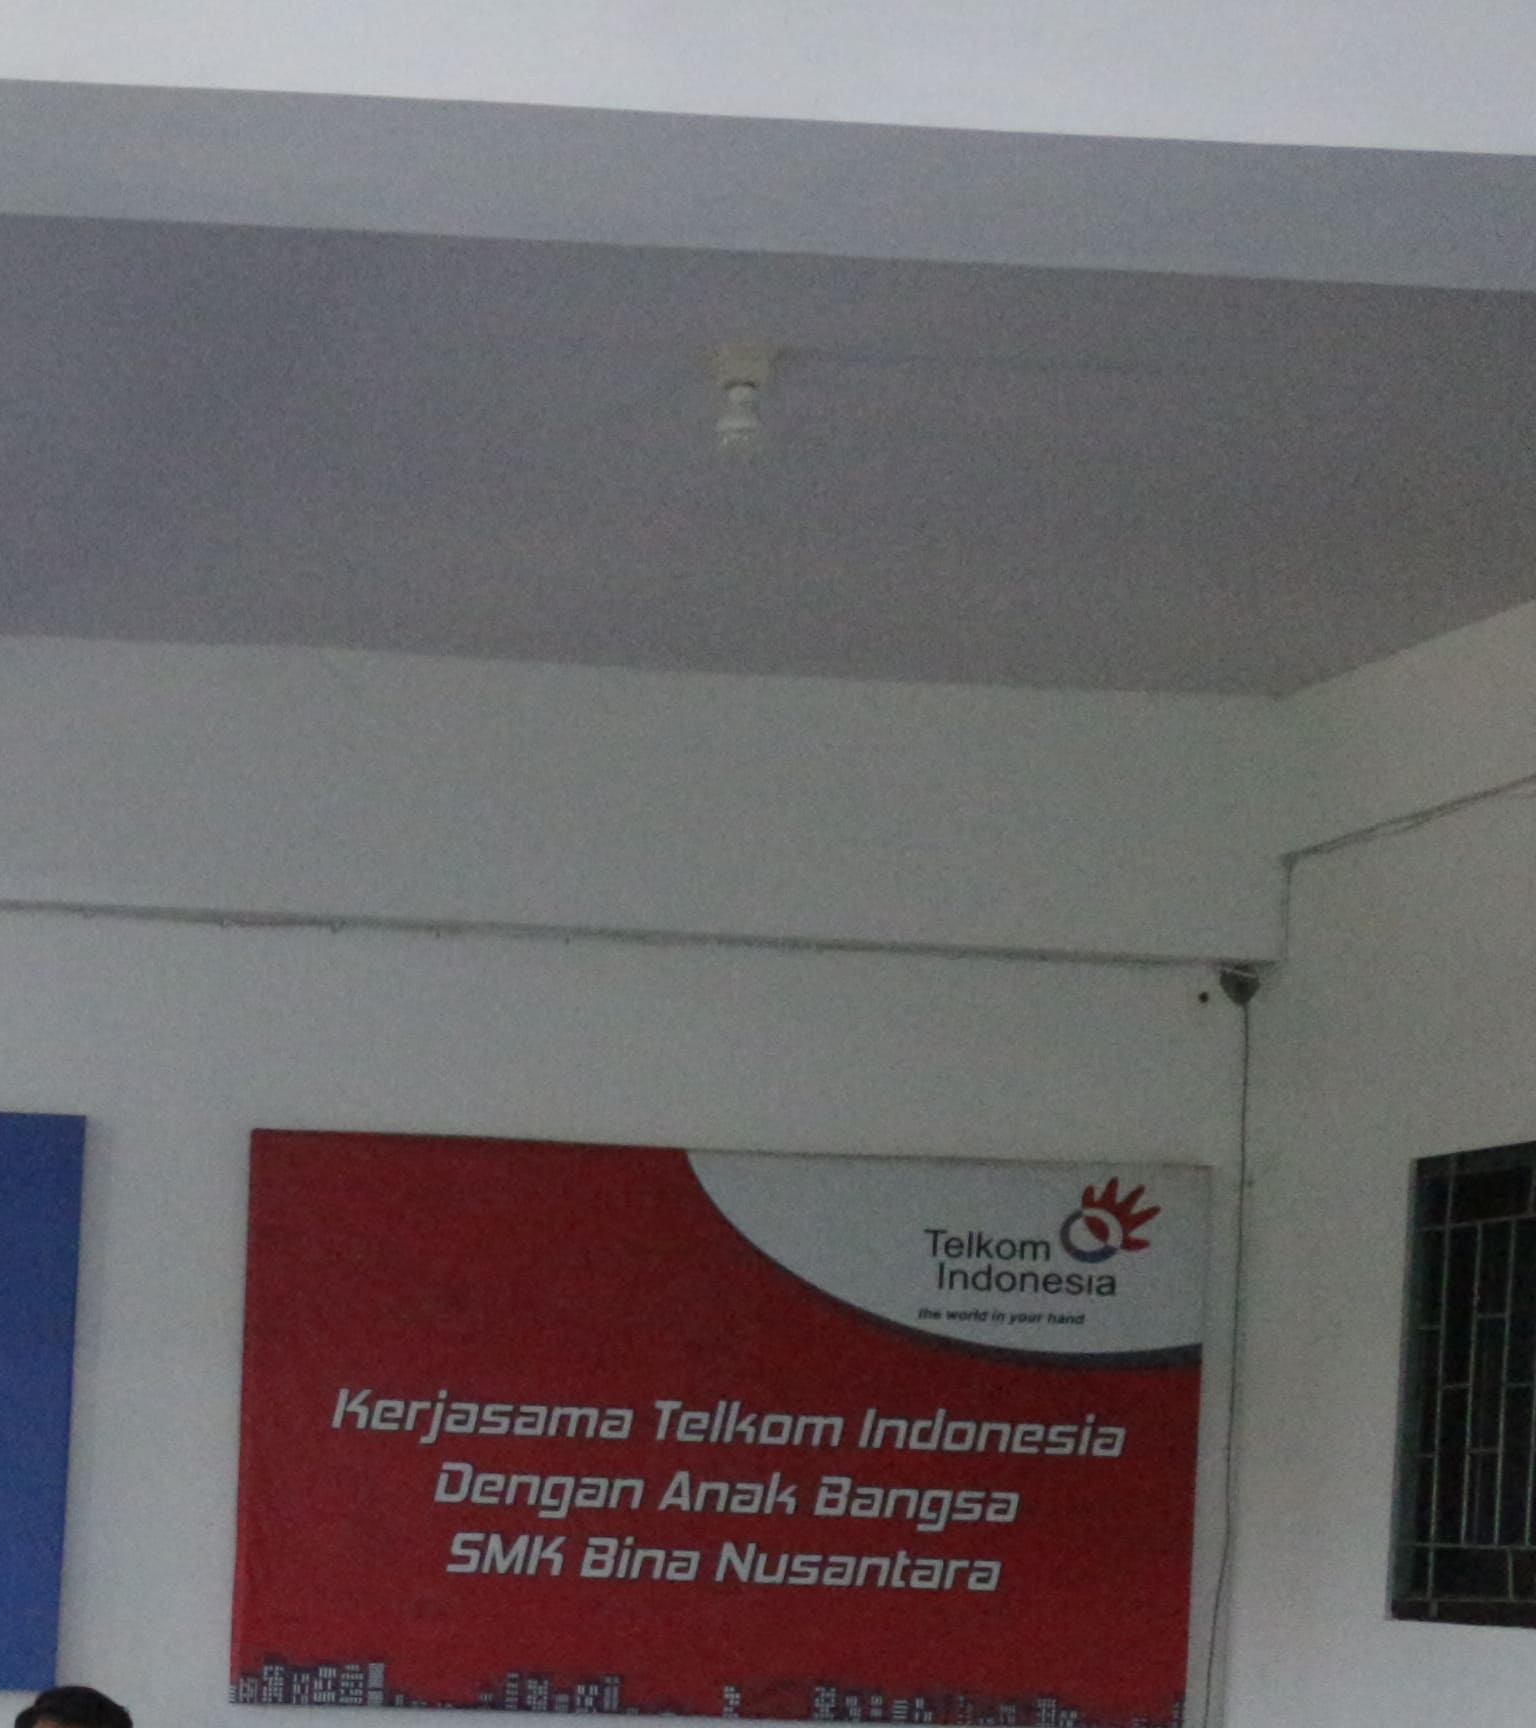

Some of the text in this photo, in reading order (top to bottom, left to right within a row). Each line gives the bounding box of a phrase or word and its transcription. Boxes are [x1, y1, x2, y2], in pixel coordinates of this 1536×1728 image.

[923, 1228, 1051, 1262] Telkom
[937, 1261, 1117, 1297] Indonesia
[331, 1387, 1127, 1458] Kerjasama Telkom Indonesia
[434, 1460, 1020, 1533] Dengan Anak Bangsa
[446, 1531, 1002, 1592] SMK Bina Nusantara
